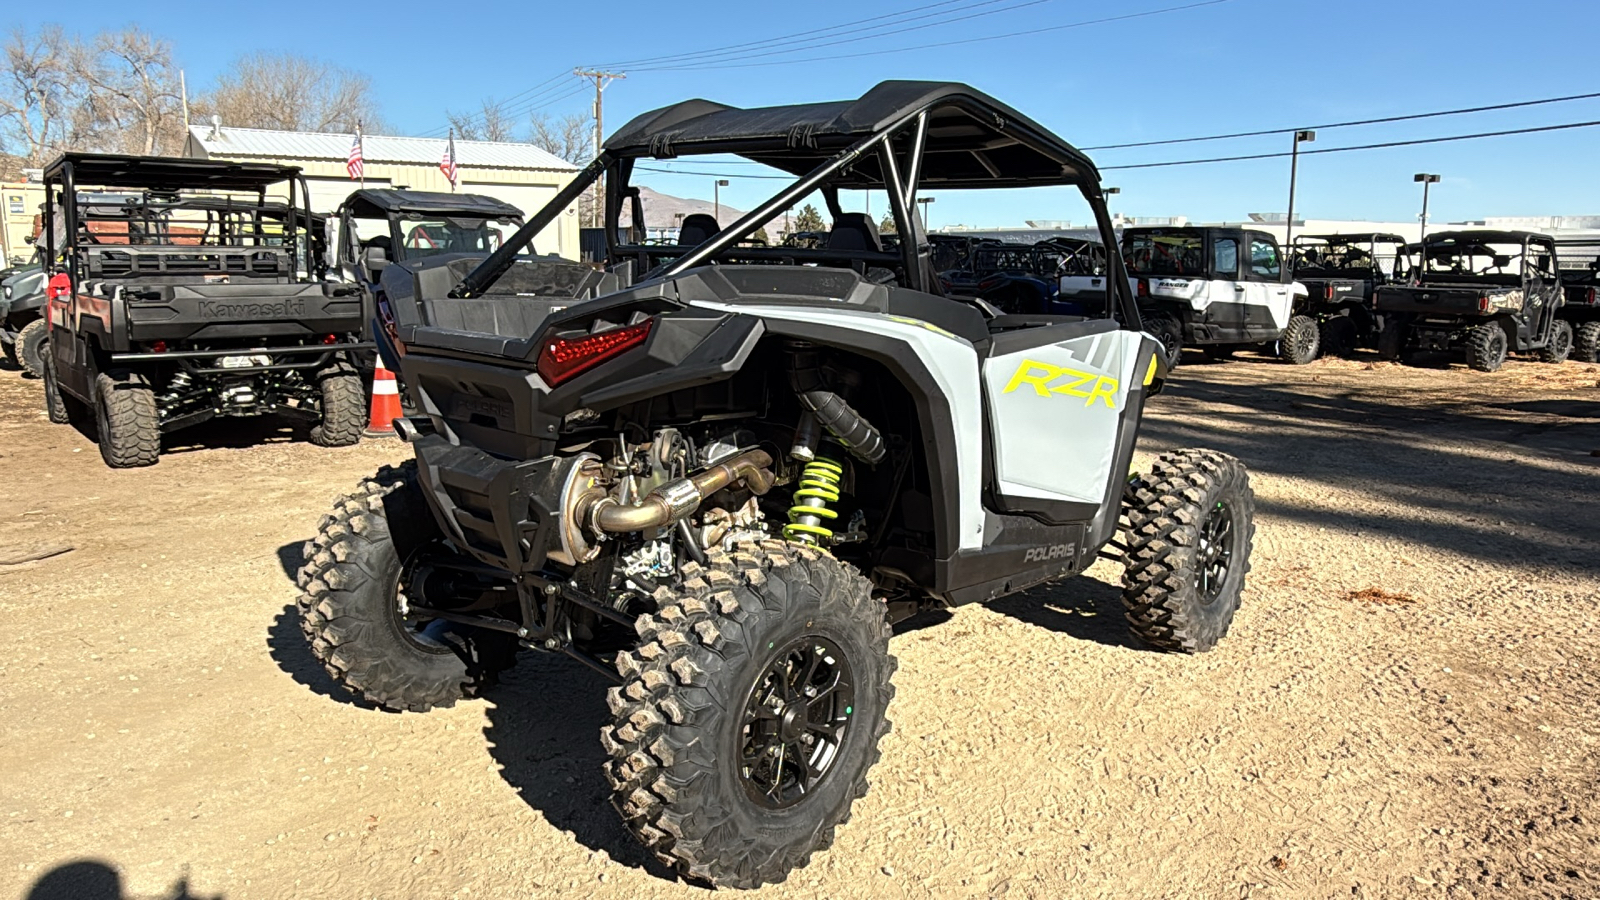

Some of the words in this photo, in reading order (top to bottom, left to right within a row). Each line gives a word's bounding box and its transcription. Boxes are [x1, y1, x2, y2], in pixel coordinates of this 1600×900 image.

[198, 299, 305, 318] Kawasaki
[1002, 358, 1120, 409] RZR
[455, 398, 510, 418] POLARIS
[1023, 543, 1075, 563] POLARIS
